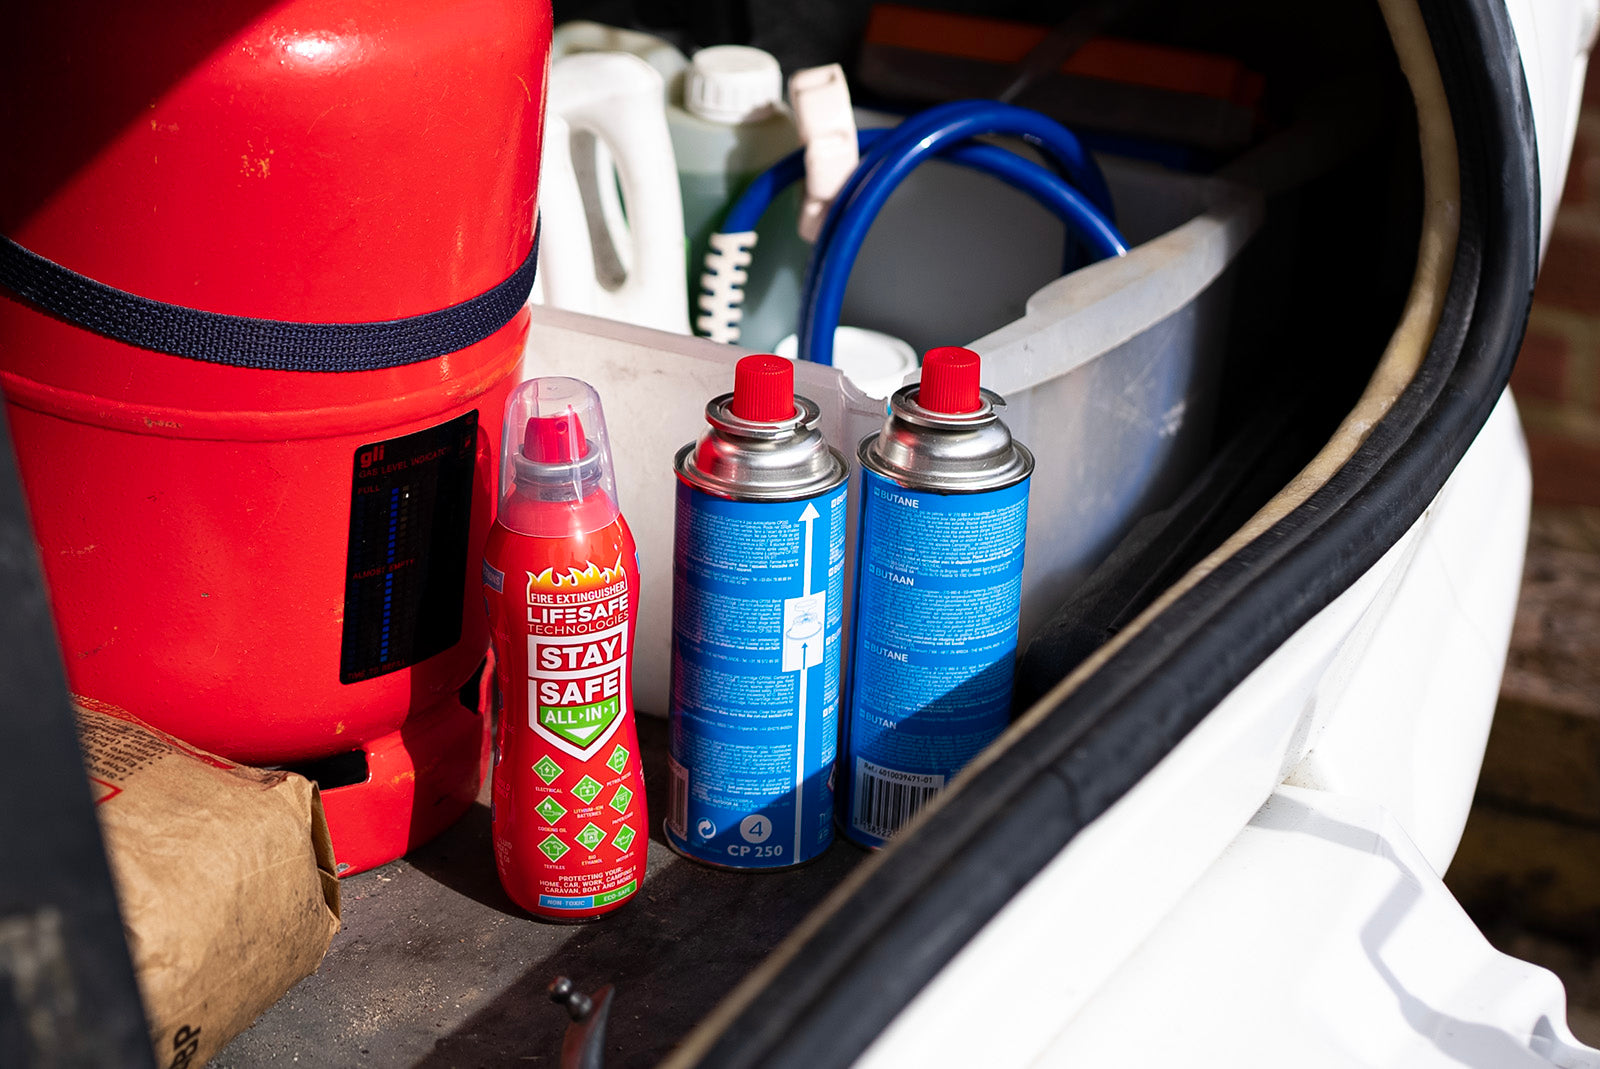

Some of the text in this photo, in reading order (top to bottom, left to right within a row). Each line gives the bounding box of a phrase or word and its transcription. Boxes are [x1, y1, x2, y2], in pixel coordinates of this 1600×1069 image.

[360, 445, 384, 468] gli
[359, 467, 377, 478] GAS
[381, 461, 408, 475] LEVEL
[357, 486, 380, 495] FULL
[881, 490, 919, 509] BUTANE
[352, 558, 415, 580] ALMOST EMPTY
[875, 567, 914, 586] BUTAAN
[531, 581, 626, 604] FIRE EXTINGUISHER
[527, 593, 629, 624] LIFESAFE
[528, 610, 630, 635] TECHNOLOGIES
[541, 636, 620, 670] STAY
[871, 643, 909, 663] BUTANE
[348, 660, 407, 681] TIME TO REFILL
[540, 671, 619, 705] SAFE
[545, 709, 577, 724] ALL
[586, 705, 602, 721] IN
[865, 712, 897, 730] BUTAN
[535, 786, 563, 794] ELECTRICAL
[577, 811, 602, 819] BATTERIES
[749, 821, 763, 837] 4
[727, 845, 750, 857] CP
[755, 845, 783, 858] 250
[540, 880, 562, 888] HOME,
[582, 879, 604, 887] WORK,
[606, 868, 632, 882] CAMPING
[559, 873, 604, 882] PROTECTING
[545, 886, 581, 894] CARAVAN,
[582, 885, 600, 893] BOAT
[602, 881, 616, 890] AND
